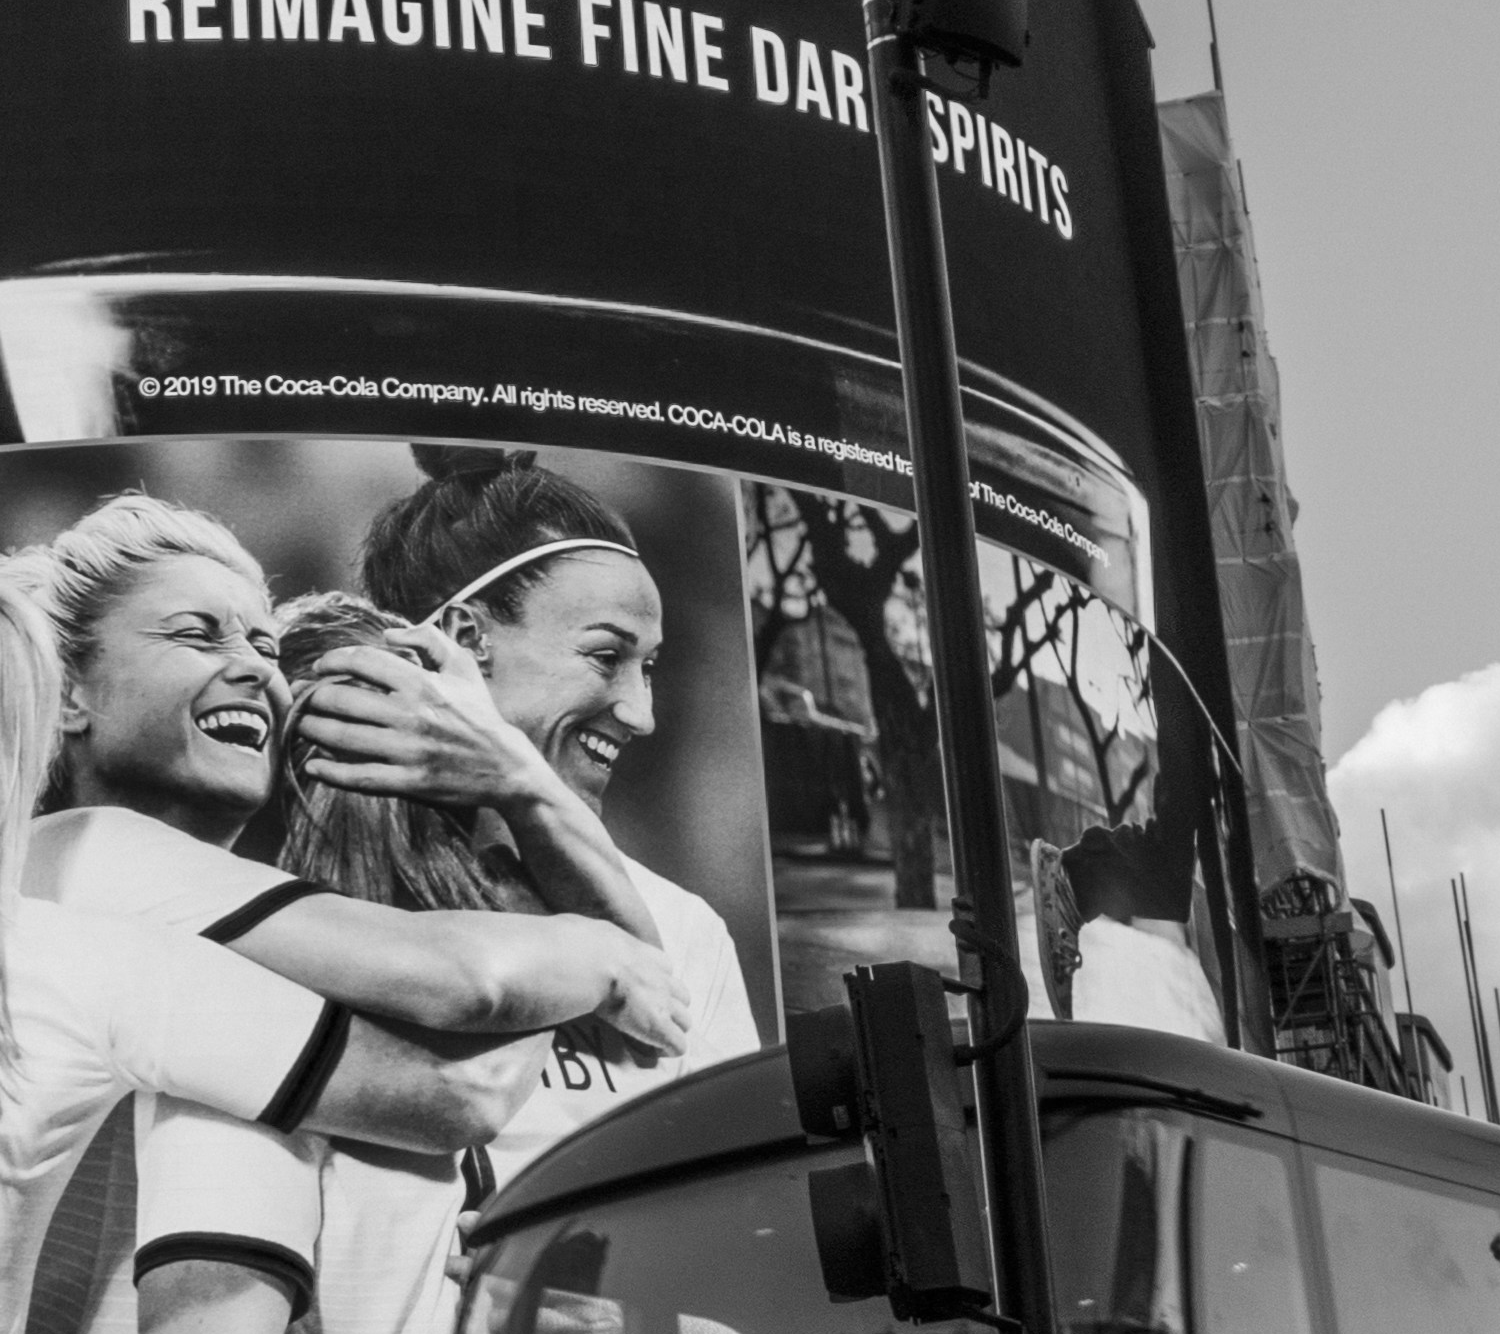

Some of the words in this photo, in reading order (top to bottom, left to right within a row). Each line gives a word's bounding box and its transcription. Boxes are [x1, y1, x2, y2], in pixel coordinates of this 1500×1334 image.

[751, 24, 879, 136] DAR
[922, 88, 1075, 241] SPIRITS
[163, 375, 216, 397] 2019
[219, 375, 262, 397] The
[264, 374, 380, 398] Coca-Cola
[381, 377, 490, 407] Company.
[491, 383, 517, 405] All
[520, 386, 576, 413] rights
[578, 394, 666, 423] reserved.
[668, 403, 787, 446] COCA-COLA
[787, 426, 802, 447] is
[804, 435, 816, 451] a
[817, 435, 895, 472] registered
[980, 482, 1006, 510] The
[1006, 494, 1066, 538] Coca-Cola
